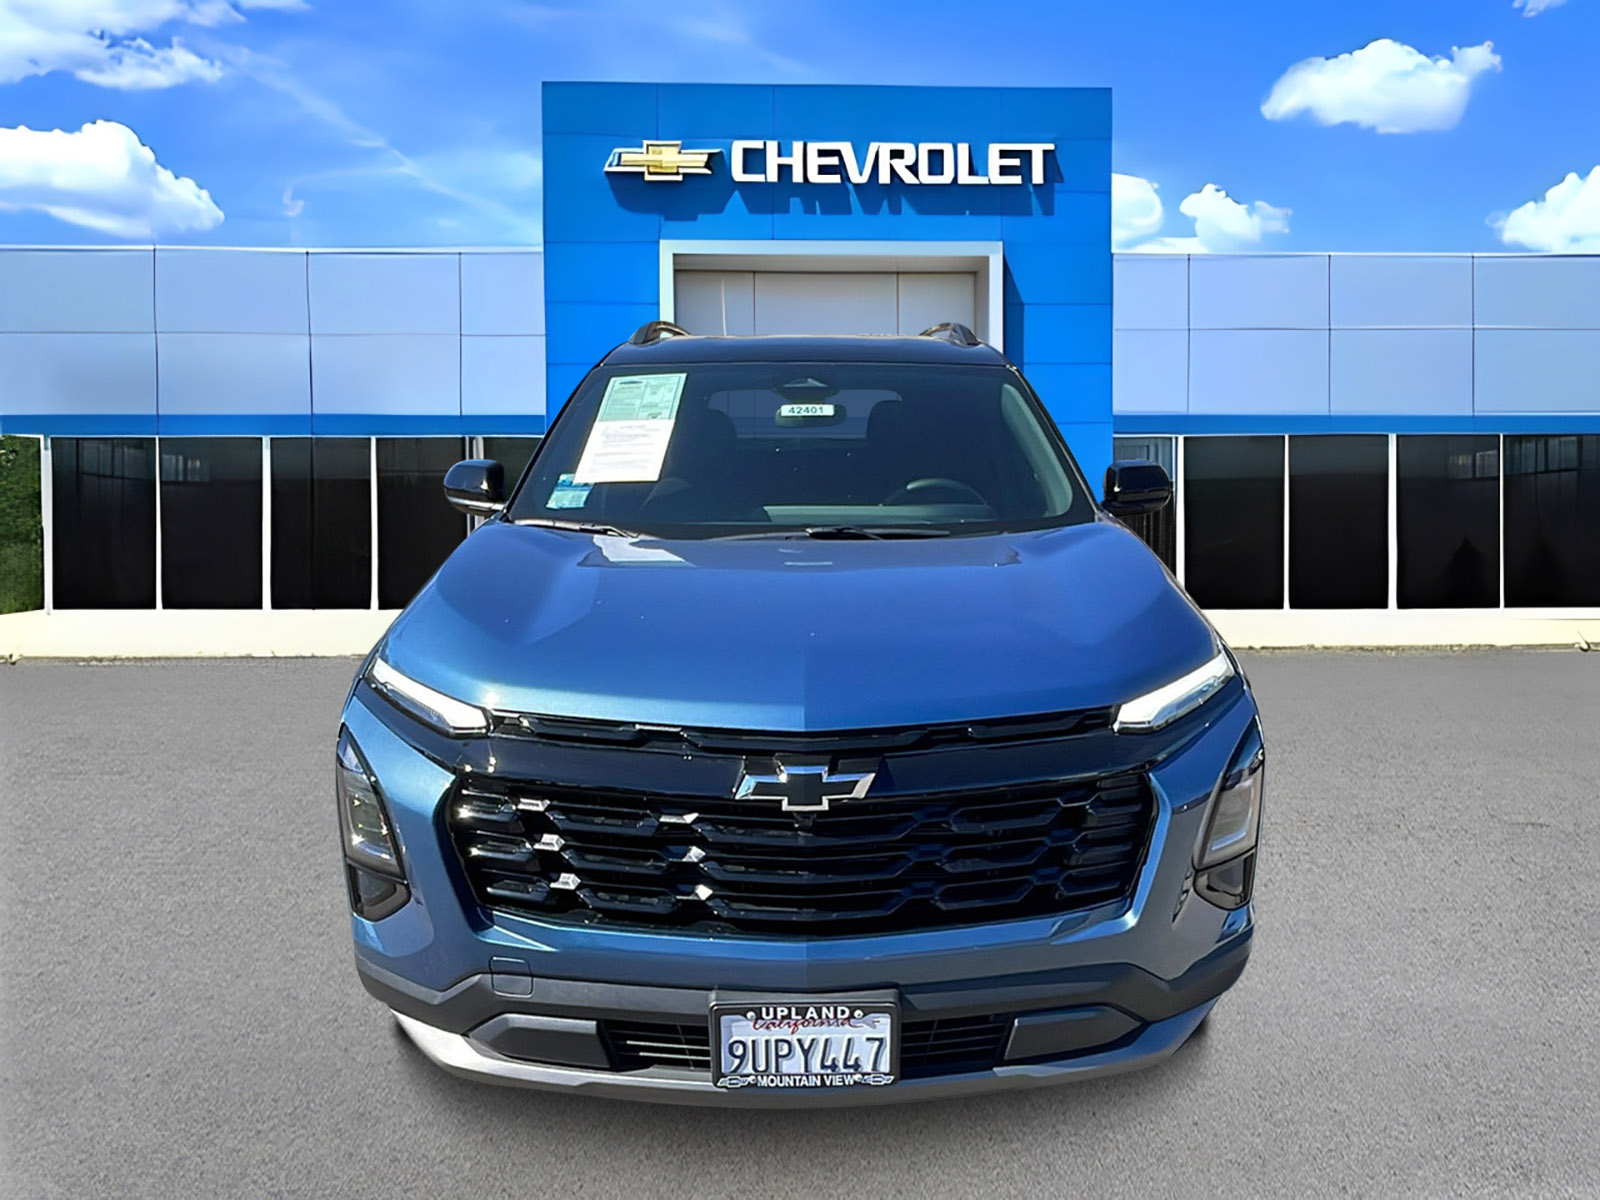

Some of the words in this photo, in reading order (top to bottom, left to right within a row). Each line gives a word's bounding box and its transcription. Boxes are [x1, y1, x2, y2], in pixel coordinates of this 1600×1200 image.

[731, 140, 1055, 185] CHEVROLET
[788, 406, 824, 414] 42401
[761, 1006, 850, 1020] UPLAND
[728, 1037, 884, 1074] 9UPY447
[757, 1075, 821, 1087] MOUNTAIN
[825, 1074, 856, 1086] VIEW
